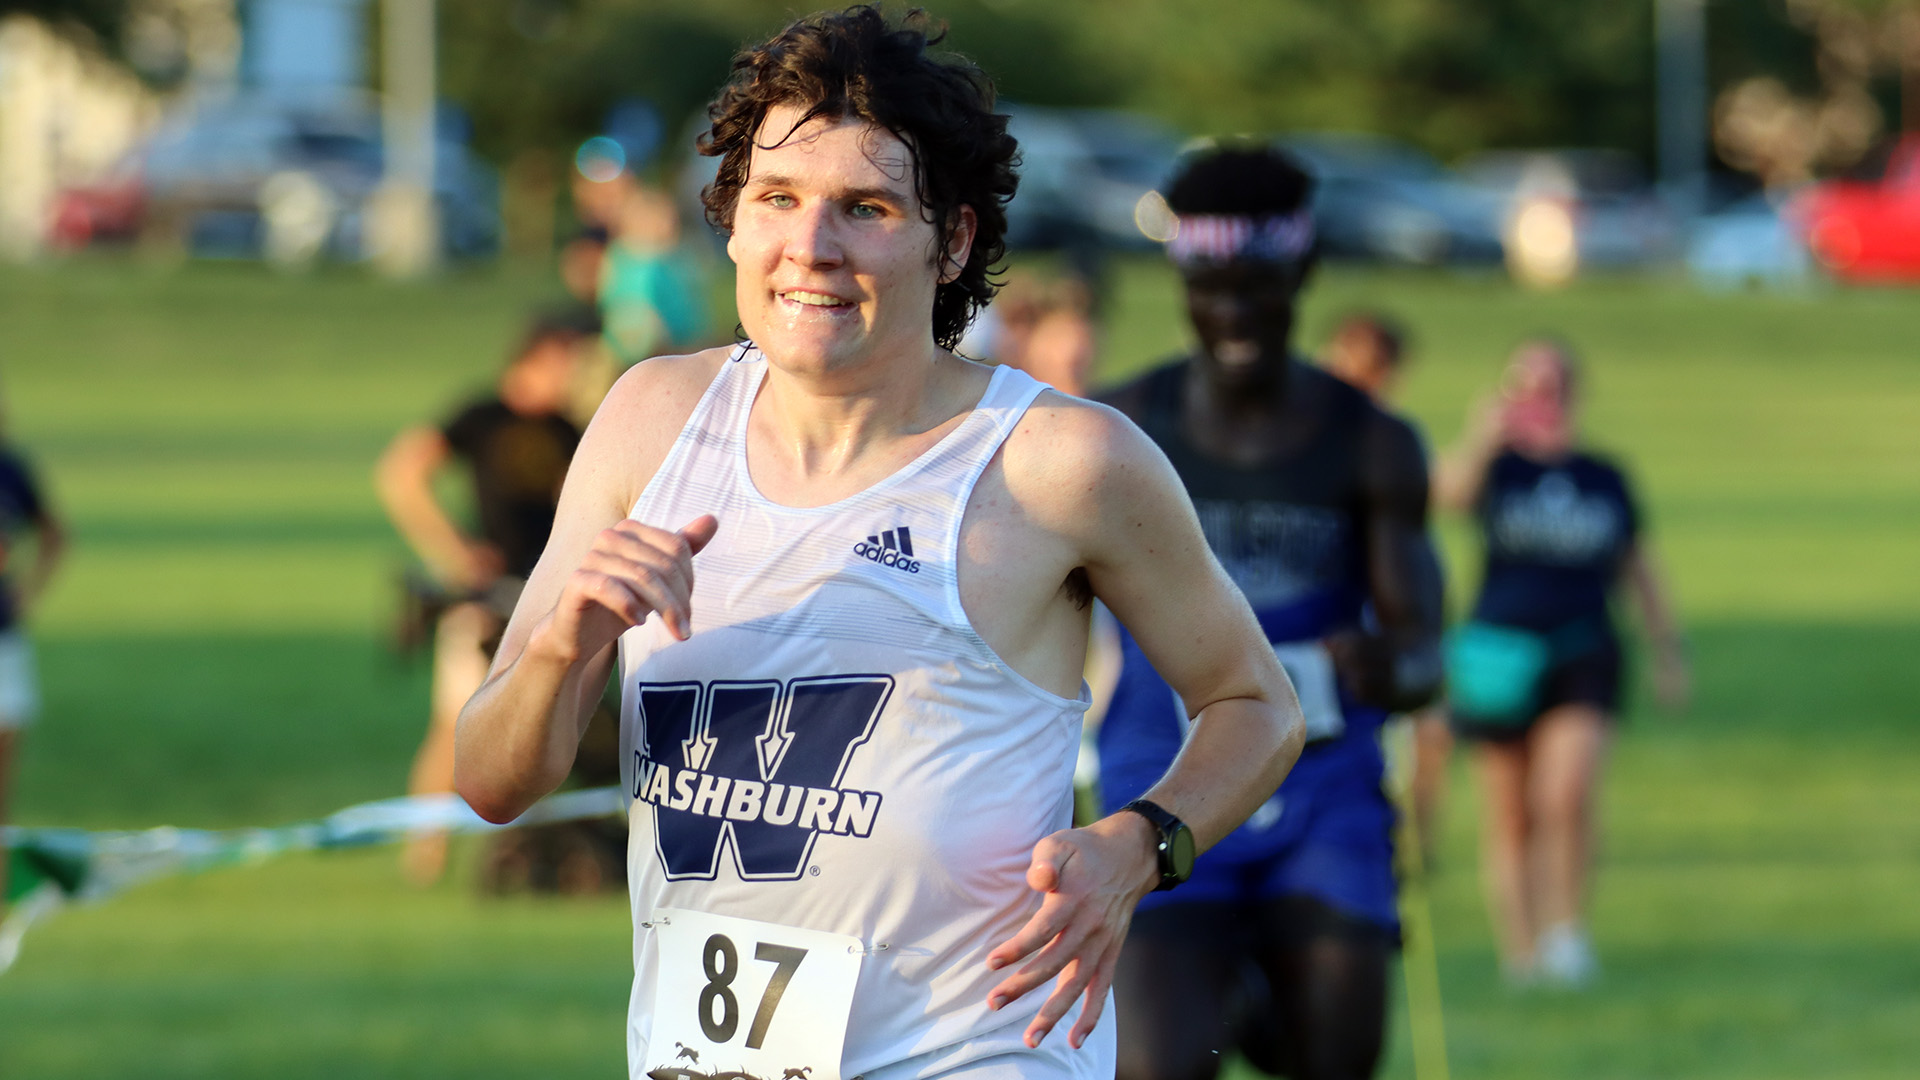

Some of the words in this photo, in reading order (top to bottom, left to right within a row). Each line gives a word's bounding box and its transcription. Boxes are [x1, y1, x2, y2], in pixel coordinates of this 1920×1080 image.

[853, 542, 921, 574] adidas
[632, 750, 883, 838] WASHBURN
[698, 933, 809, 1050] 87
